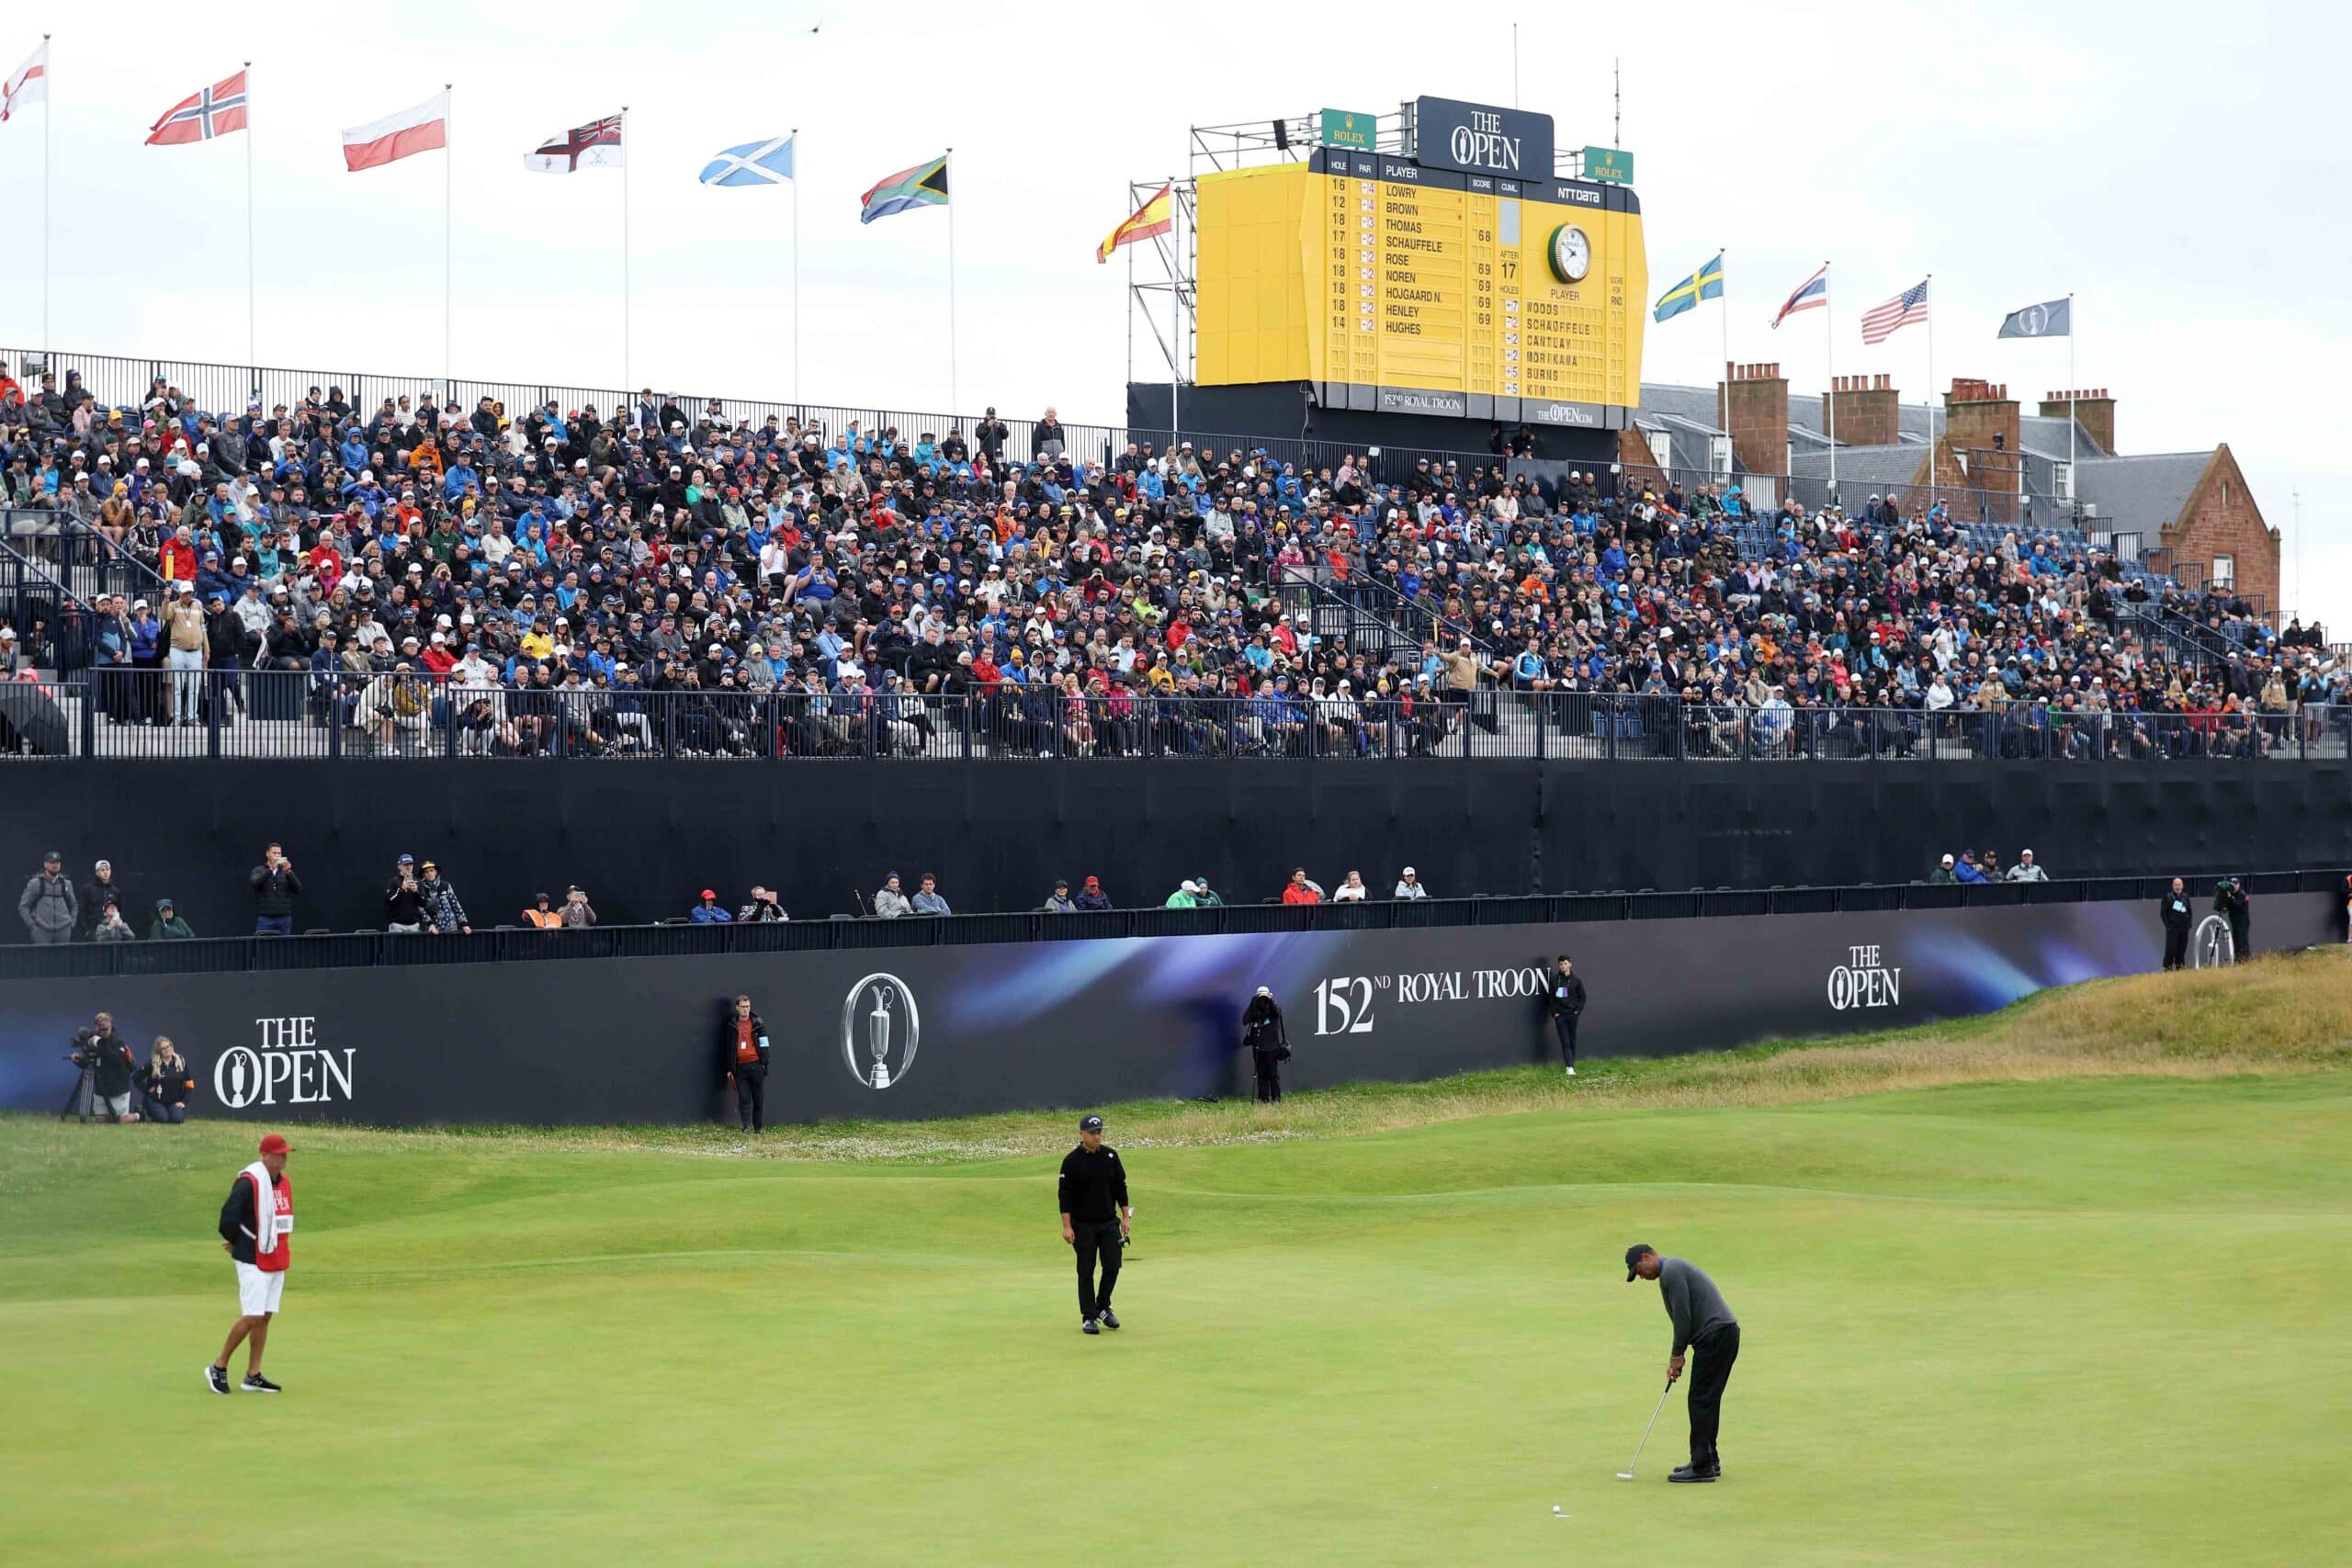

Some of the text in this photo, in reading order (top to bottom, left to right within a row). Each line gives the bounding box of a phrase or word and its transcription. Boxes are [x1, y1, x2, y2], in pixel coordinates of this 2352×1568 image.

[1471, 111, 1500, 133] THE
[1334, 130, 1365, 144] ROLEX
[1452, 126, 1521, 172] OPEN
[1331, 162, 1347, 170] HOLE
[1359, 164, 1372, 174] PAR
[1385, 165, 1418, 179] PLAYER
[1472, 179, 1491, 189] SCORE
[1595, 166, 1623, 180] ROLEX
[1332, 178, 1345, 191] 16
[1386, 185, 1417, 198] LOWRY
[1332, 196, 1345, 208] 12
[1386, 202, 1419, 216] BROWN
[1332, 212, 1345, 225] 18
[1385, 219, 1422, 233] THOMAS
[1478, 230, 1491, 242] 68
[1332, 231, 1345, 243] 17
[1386, 236, 1442, 253] SCHAUFFELE
[1332, 247, 1345, 260] 18
[1386, 254, 1409, 265] ROSE
[1478, 264, 1491, 275] 69
[1500, 250, 1519, 259] AFTER
[1332, 265, 1345, 276] 18
[1386, 270, 1416, 283] NOREN
[1478, 280, 1491, 291] 69
[1502, 263, 1516, 279] 17
[1386, 288, 1432, 301] HOJGAARD
[1478, 297, 1491, 308] 69
[1499, 286, 1519, 294] HOLES
[1551, 288, 1579, 300] PLAYER
[1507, 301, 1558, 315] +7 WOODS
[1611, 296, 1623, 306] RND
[1332, 299, 1345, 311] 18
[1386, 305, 1419, 317] HENLEY
[1478, 313, 1491, 324] 69
[1332, 316, 1345, 328] 14
[1386, 321, 1421, 334] HUGHES
[1527, 319, 1590, 335] SCHAUFFELE
[1507, 333, 1571, 349] +2 CANTLAY
[1507, 351, 1577, 367] +2 MORIKAWA
[1527, 368, 1558, 381] BURNS
[1527, 385, 1545, 397] KIM
[1404, 396, 1430, 408] ROYAL
[1431, 398, 1460, 410] TROON
[1849, 945, 1881, 967] THE
[1398, 972, 1469, 1003] ROYAL
[1473, 967, 1551, 998] TROON
[1827, 965, 1901, 1010] OPEN
[256, 1017, 316, 1048] THE
[214, 1046, 356, 1108] OPEN
